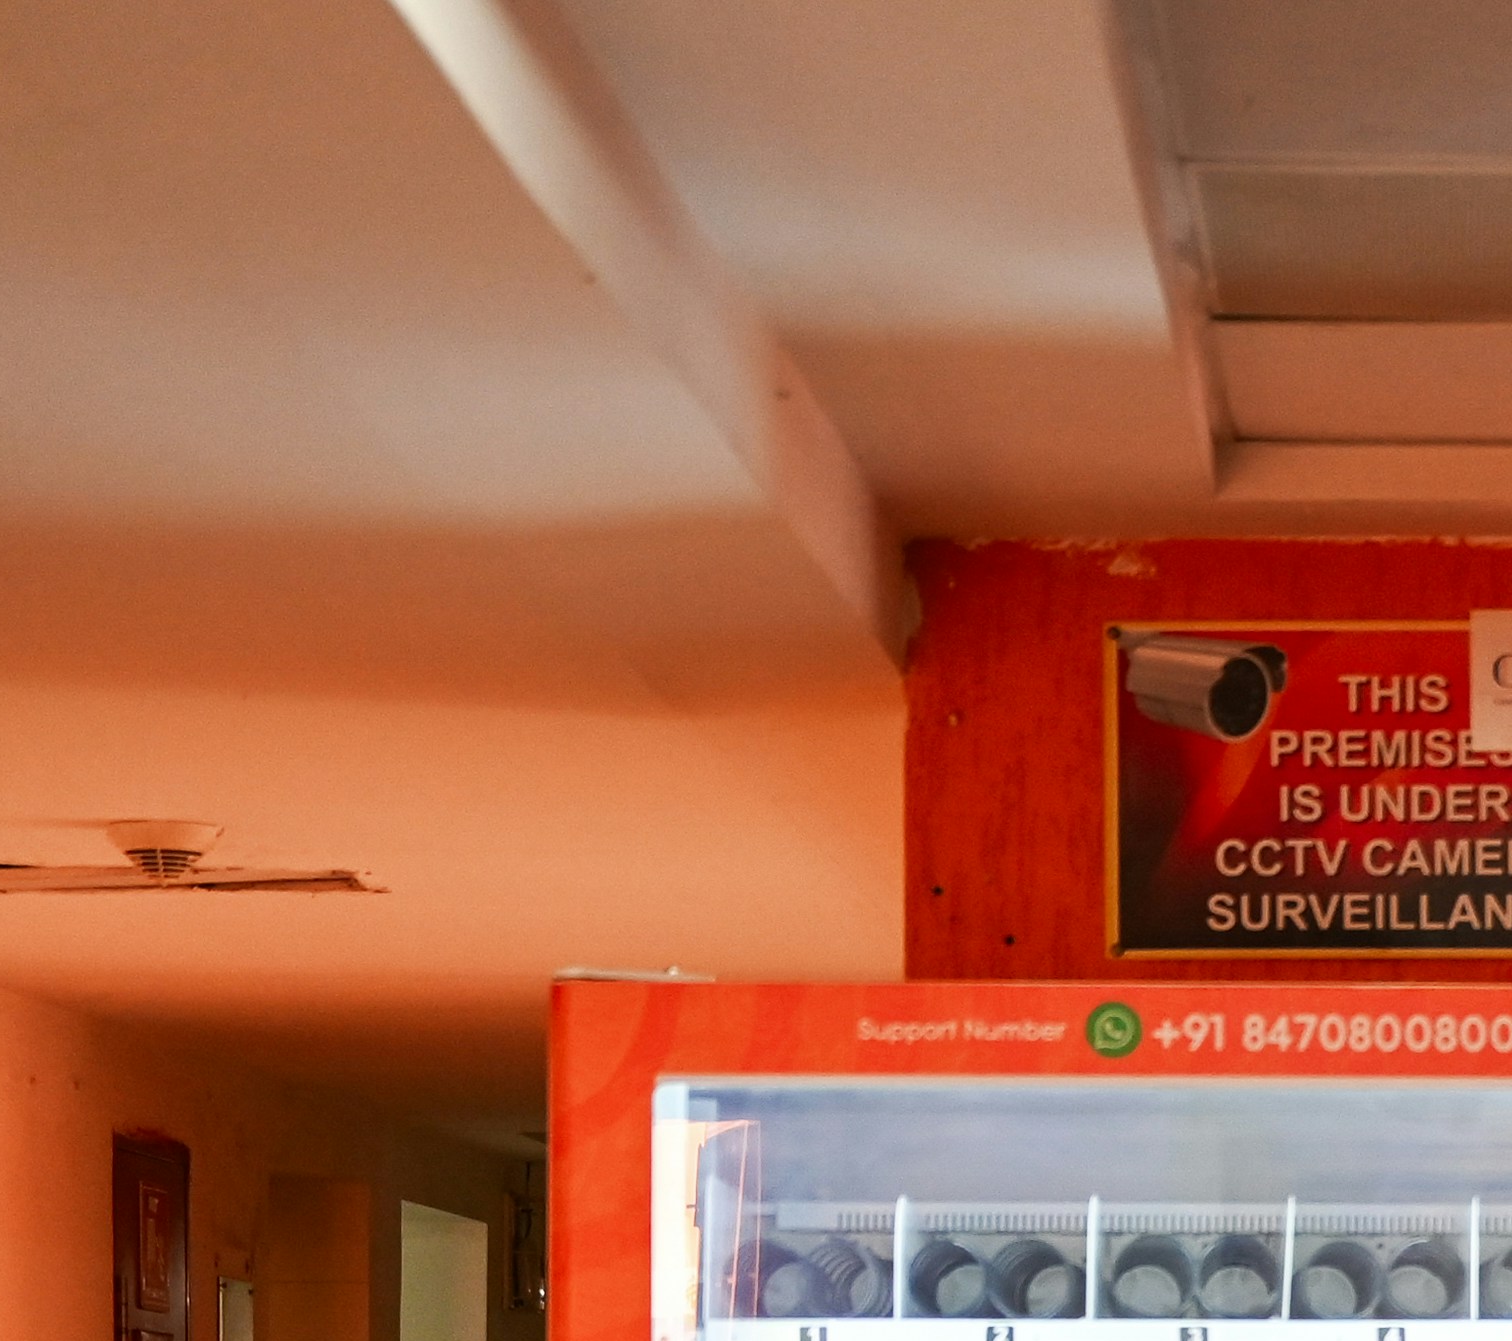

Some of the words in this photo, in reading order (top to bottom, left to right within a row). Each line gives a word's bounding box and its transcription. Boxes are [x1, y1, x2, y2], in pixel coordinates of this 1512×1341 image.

[1338, 673, 1451, 714] THIS
[1279, 783, 1323, 824] IS
[1339, 783, 1512, 824] UNDER
[1214, 838, 1349, 878] CCTV
[857, 1016, 958, 1046] Support
[963, 1017, 1067, 1042] Number
[1152, 1013, 1225, 1053] +91
